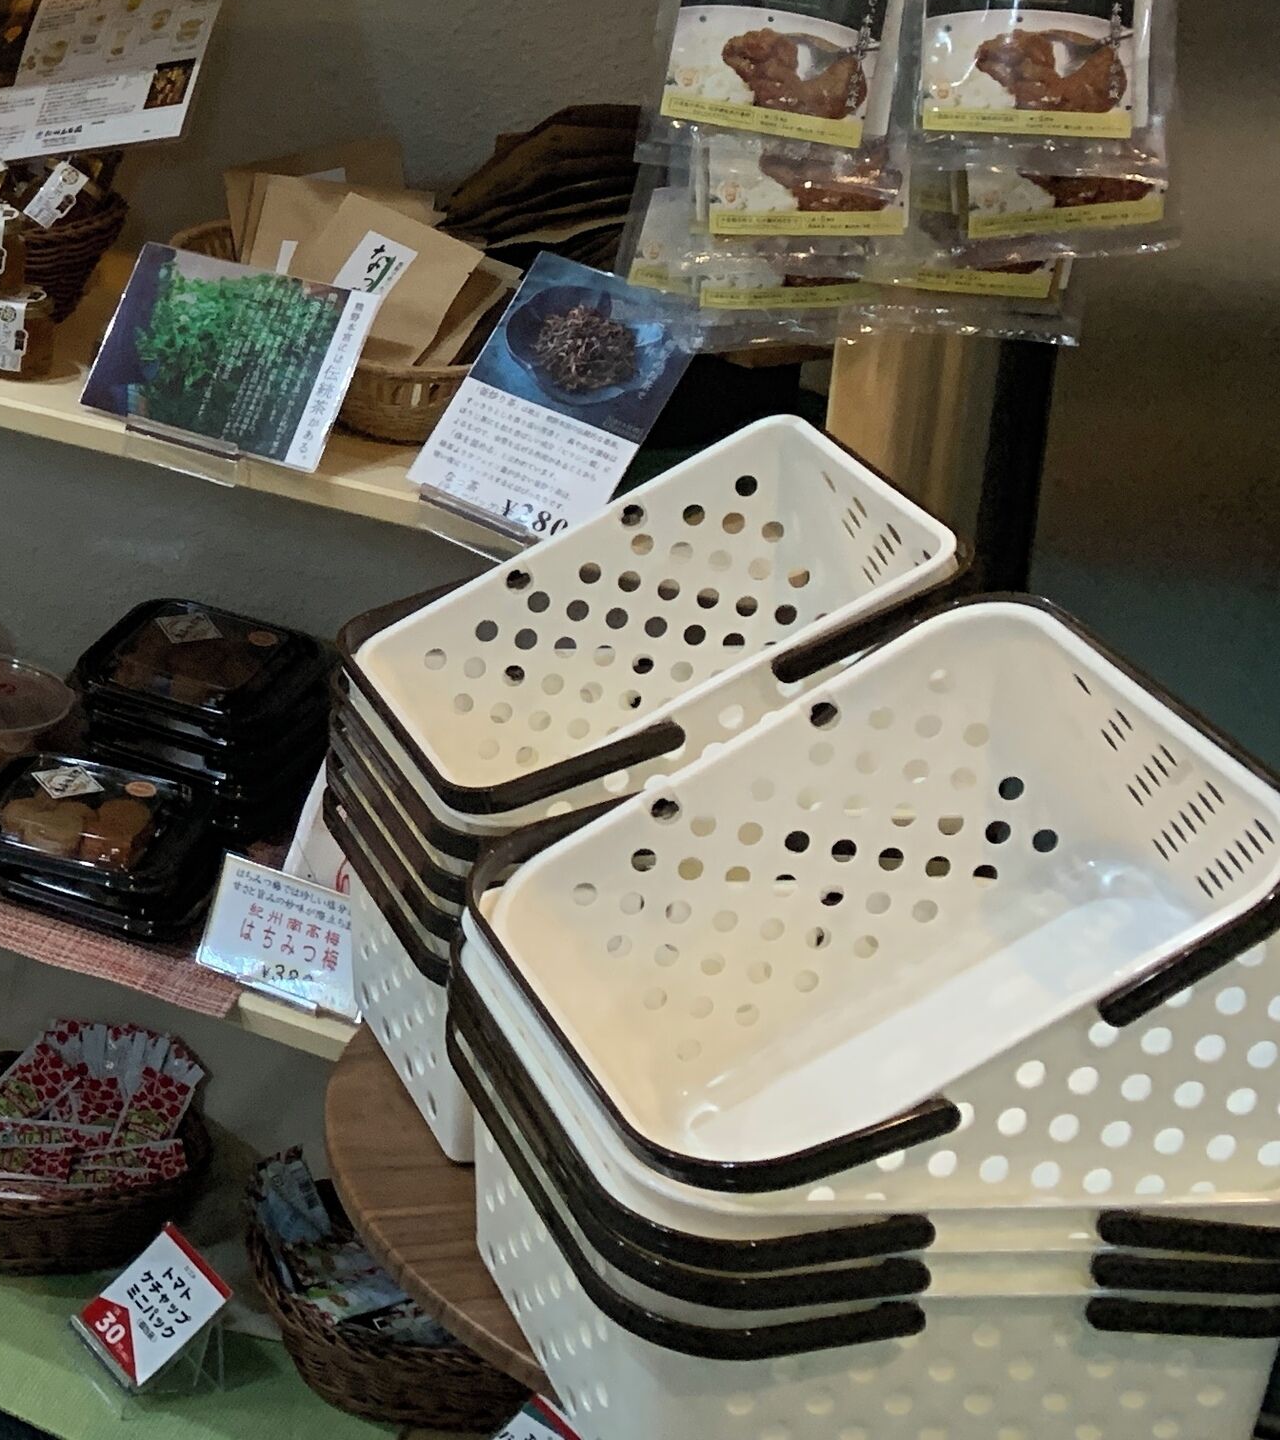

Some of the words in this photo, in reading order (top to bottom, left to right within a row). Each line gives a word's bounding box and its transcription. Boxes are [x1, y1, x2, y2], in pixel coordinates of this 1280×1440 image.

[240, 918, 339, 972] はちみつ梅
[248, 903, 341, 946] 紀州南高梅
[126, 1283, 175, 1338] ミニパック
[141, 1270, 192, 1324] ケチャップ
[162, 1267, 191, 1301] トマト
